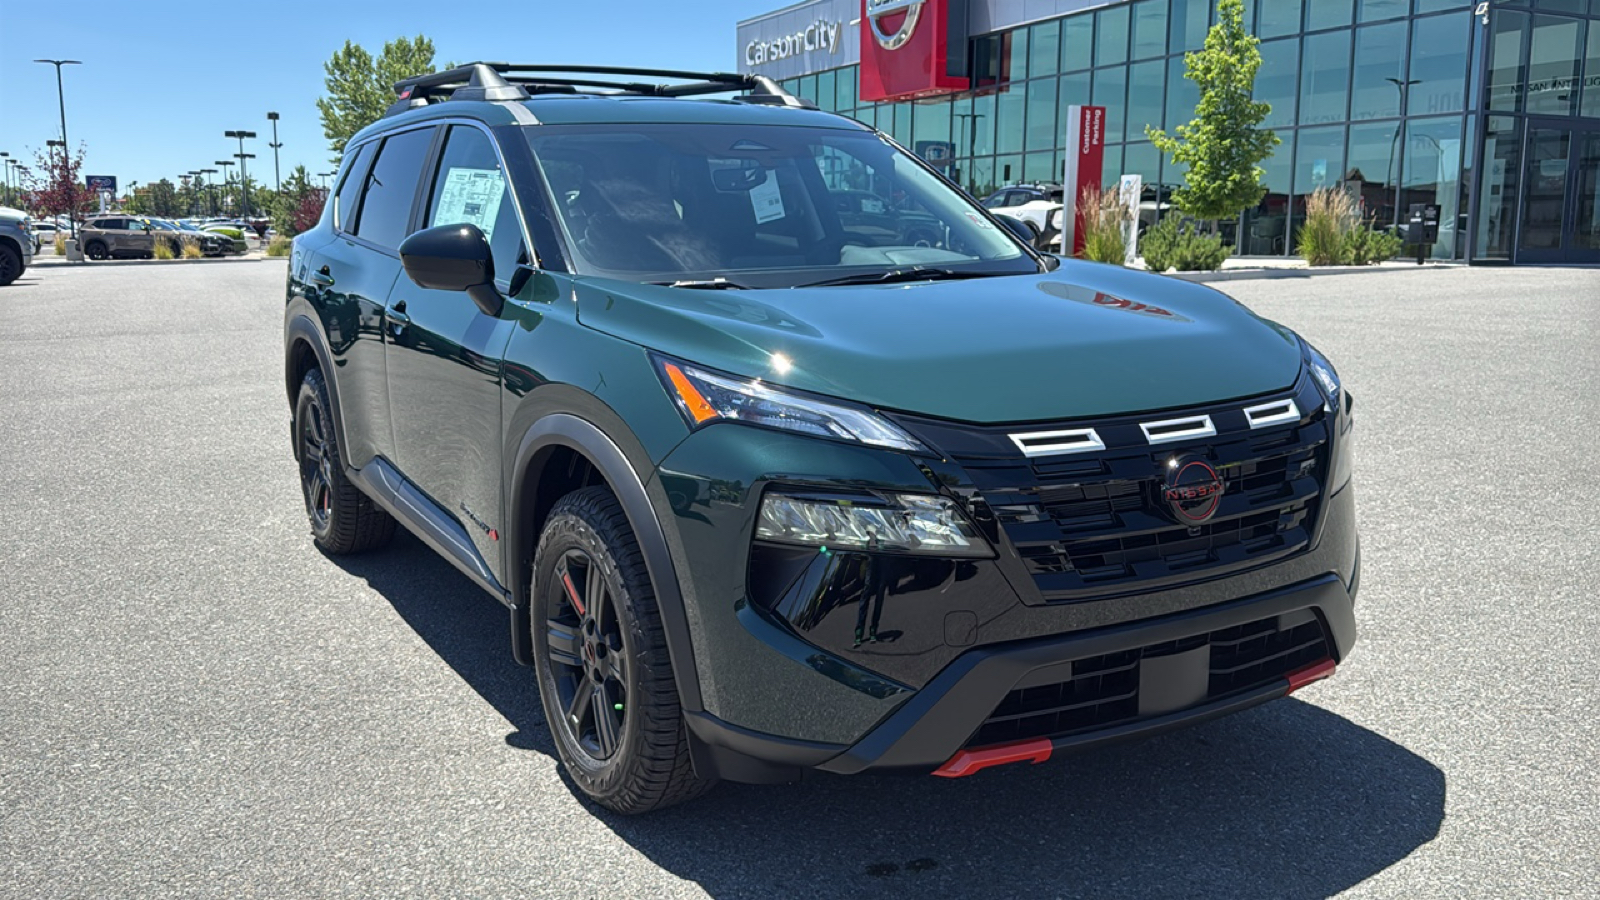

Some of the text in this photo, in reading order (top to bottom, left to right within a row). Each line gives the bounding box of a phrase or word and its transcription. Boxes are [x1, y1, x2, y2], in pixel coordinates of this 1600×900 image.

[745, 20, 839, 66] Carson City
[1083, 109, 1091, 154] Customer
[1092, 109, 1101, 145] Parking
[1166, 484, 1222, 499] NISSAN
